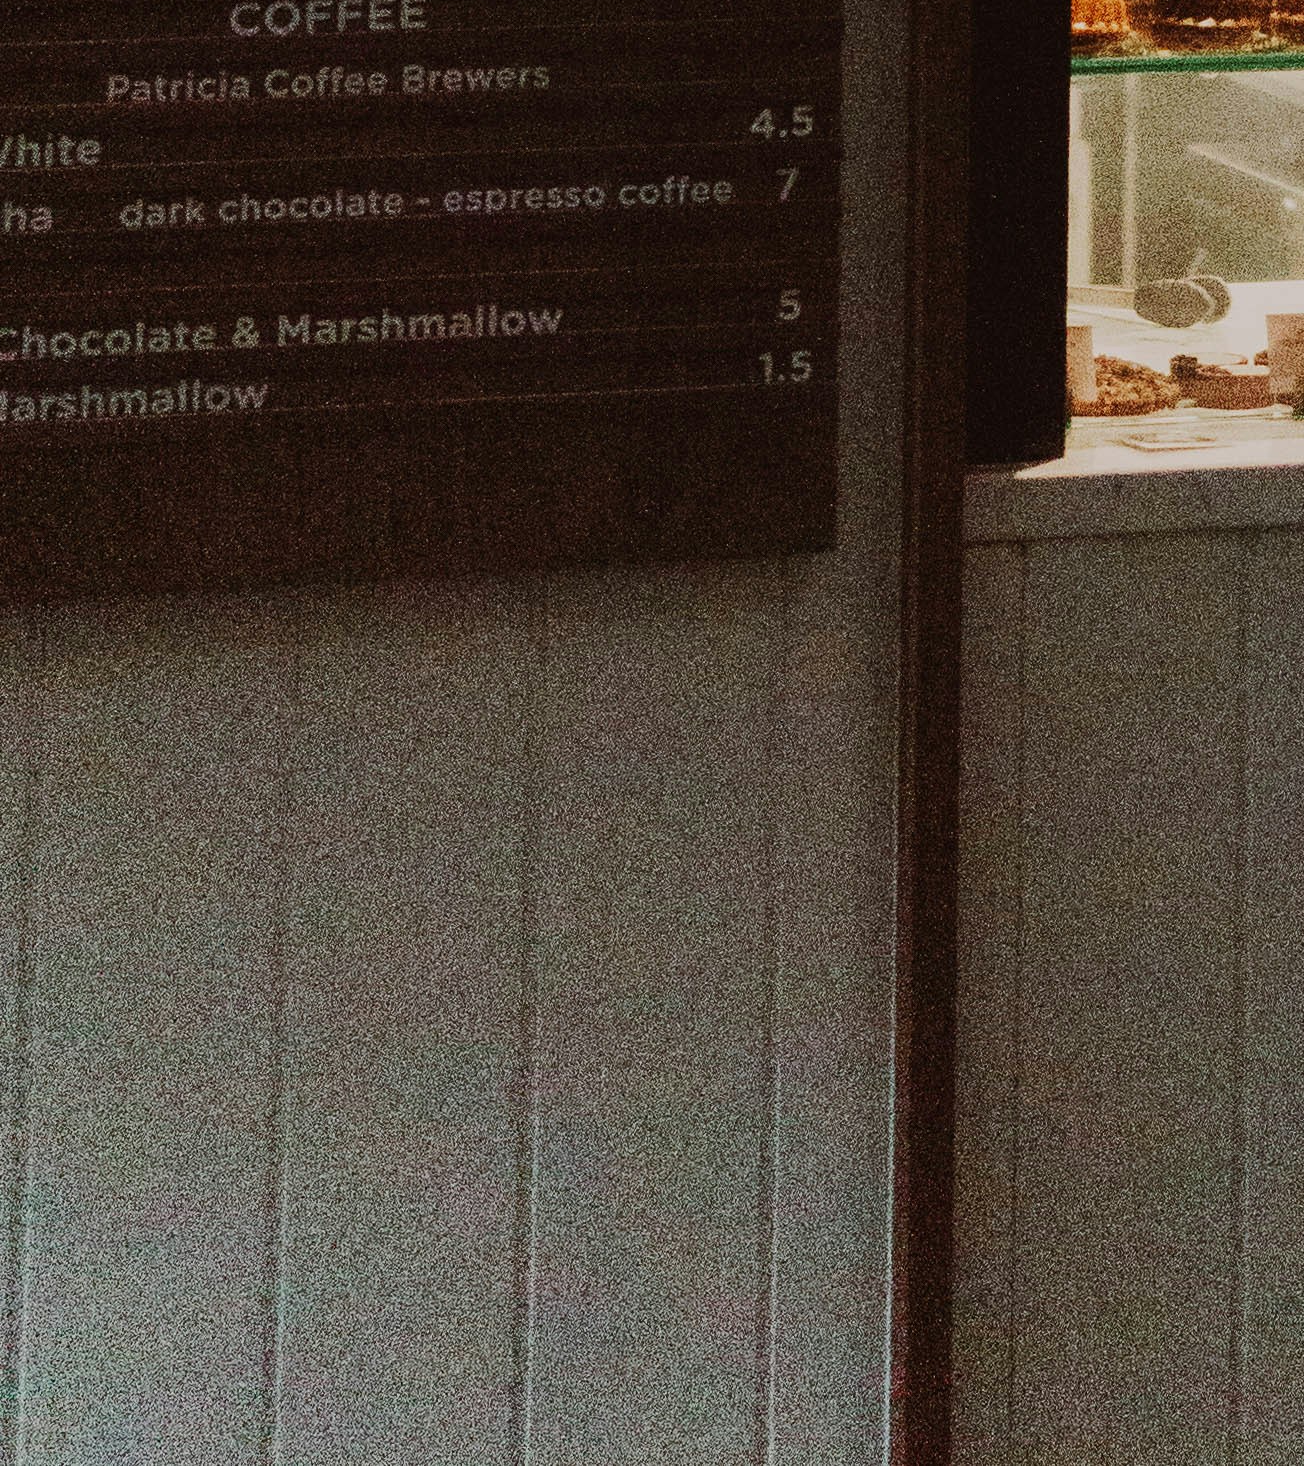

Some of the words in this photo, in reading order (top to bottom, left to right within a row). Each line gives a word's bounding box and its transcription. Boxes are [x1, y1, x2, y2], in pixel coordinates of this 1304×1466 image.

[106, 70, 250, 104] Patricia
[263, 65, 389, 99] Coffee
[401, 64, 551, 93] Brewers
[749, 106, 815, 140] 4.5
[0, 132, 103, 168] hite
[118, 200, 206, 230] dark
[216, 189, 404, 225] chocolate
[442, 184, 606, 214] espresso
[616, 174, 734, 207] coffee
[775, 168, 799, 201] 7
[777, 288, 802, 321] 5
[232, 316, 260, 349] &
[276, 306, 564, 347] Marshmallow
[757, 350, 813, 384] 1.5
[0, 380, 270, 423] arshmallow
